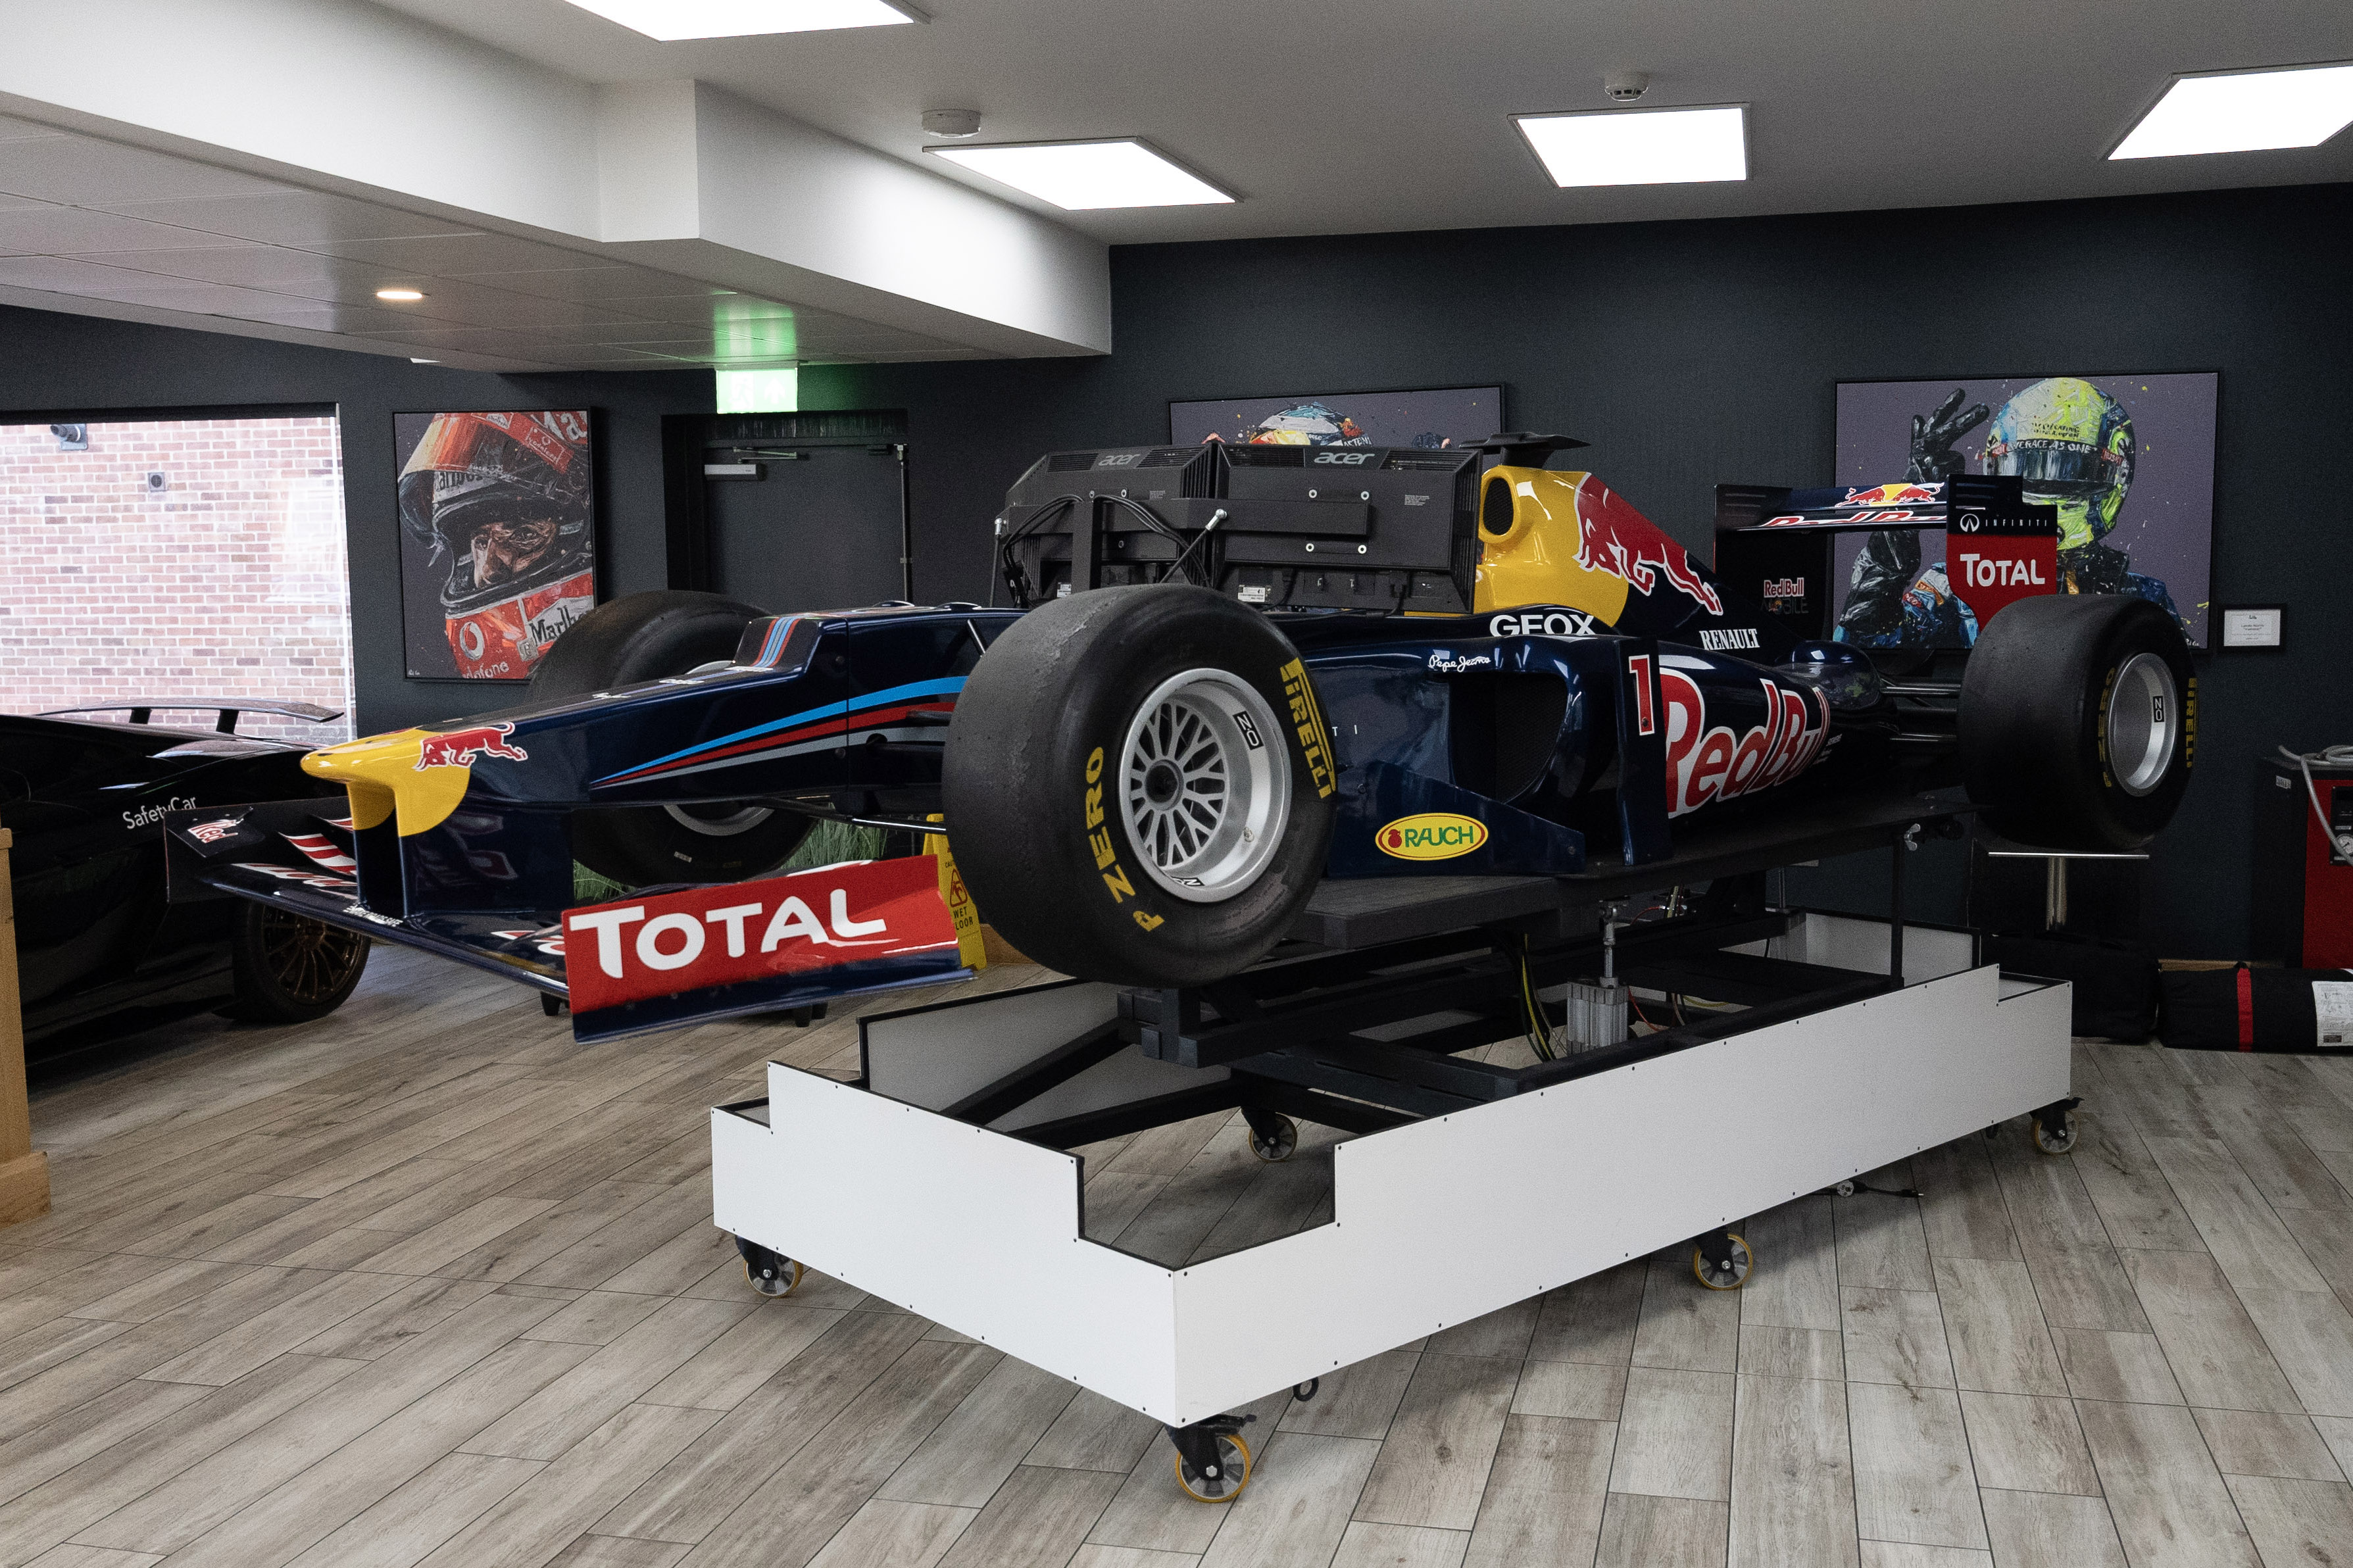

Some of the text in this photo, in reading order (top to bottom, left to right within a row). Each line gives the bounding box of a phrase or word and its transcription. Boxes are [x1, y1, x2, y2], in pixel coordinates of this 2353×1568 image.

[1098, 453, 1141, 466] acer
[1314, 452, 1375, 465] acer
[1960, 553, 2046, 587] TOTAL
[1764, 577, 1804, 598] Red Bull
[528, 605, 587, 645] Marlb
[1489, 613, 1597, 637] GEOX
[1699, 628, 1760, 650] RENAULT
[1427, 654, 1491, 673] Pepe Jeans
[1629, 654, 1655, 736] 1
[1280, 657, 1337, 798] PIRELLI
[1659, 667, 1831, 820] Red Bull
[1085, 747, 1165, 932] P ZERO
[1404, 825, 1474, 848] RAUCH
[953, 906, 967, 919] WET
[955, 916, 974, 931] LOOR
[569, 889, 887, 979] TOTAL
